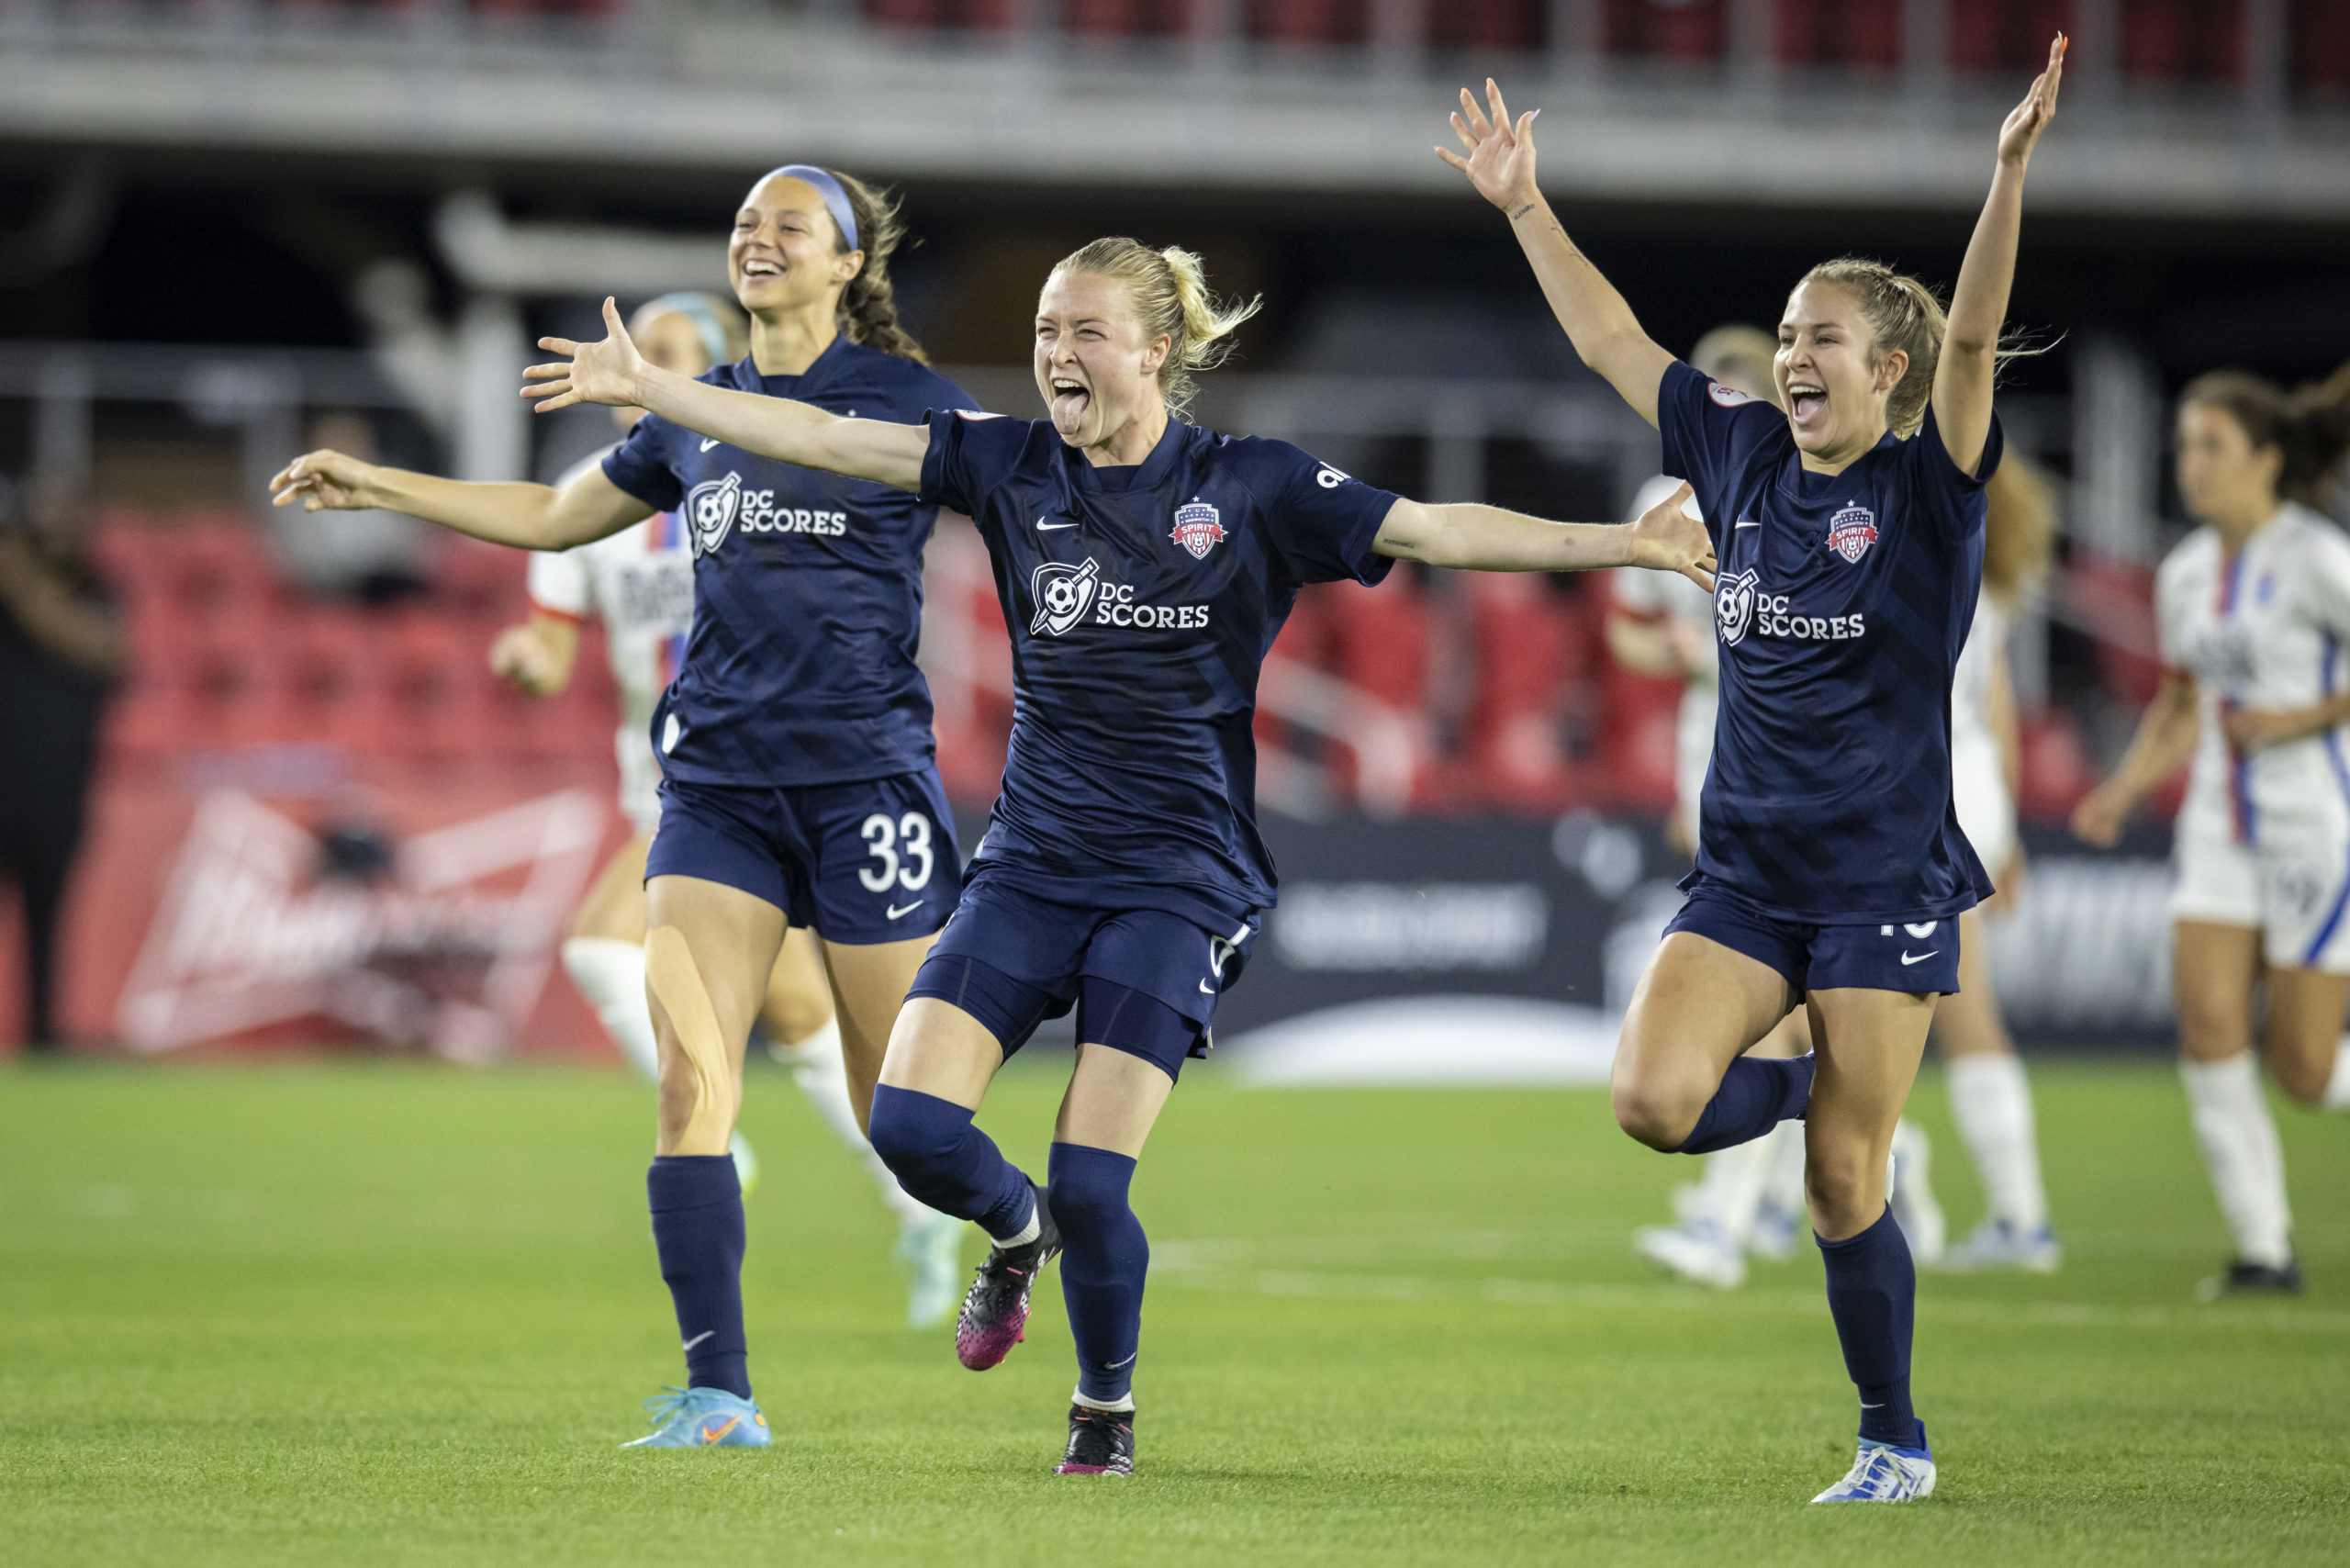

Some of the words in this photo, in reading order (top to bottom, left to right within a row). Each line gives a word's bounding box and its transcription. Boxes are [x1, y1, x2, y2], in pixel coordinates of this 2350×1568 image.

[742, 489, 774, 509] DC
[740, 509, 846, 536] SCORES
[1181, 523, 1214, 533] SPIRIT
[1836, 527, 1869, 540] SPIRIT
[1099, 582, 1134, 603] DC
[1757, 593, 1789, 614] DC
[1096, 601, 1209, 629] SCORES
[1758, 613, 1865, 639] SCORES
[858, 812, 934, 892] 33
